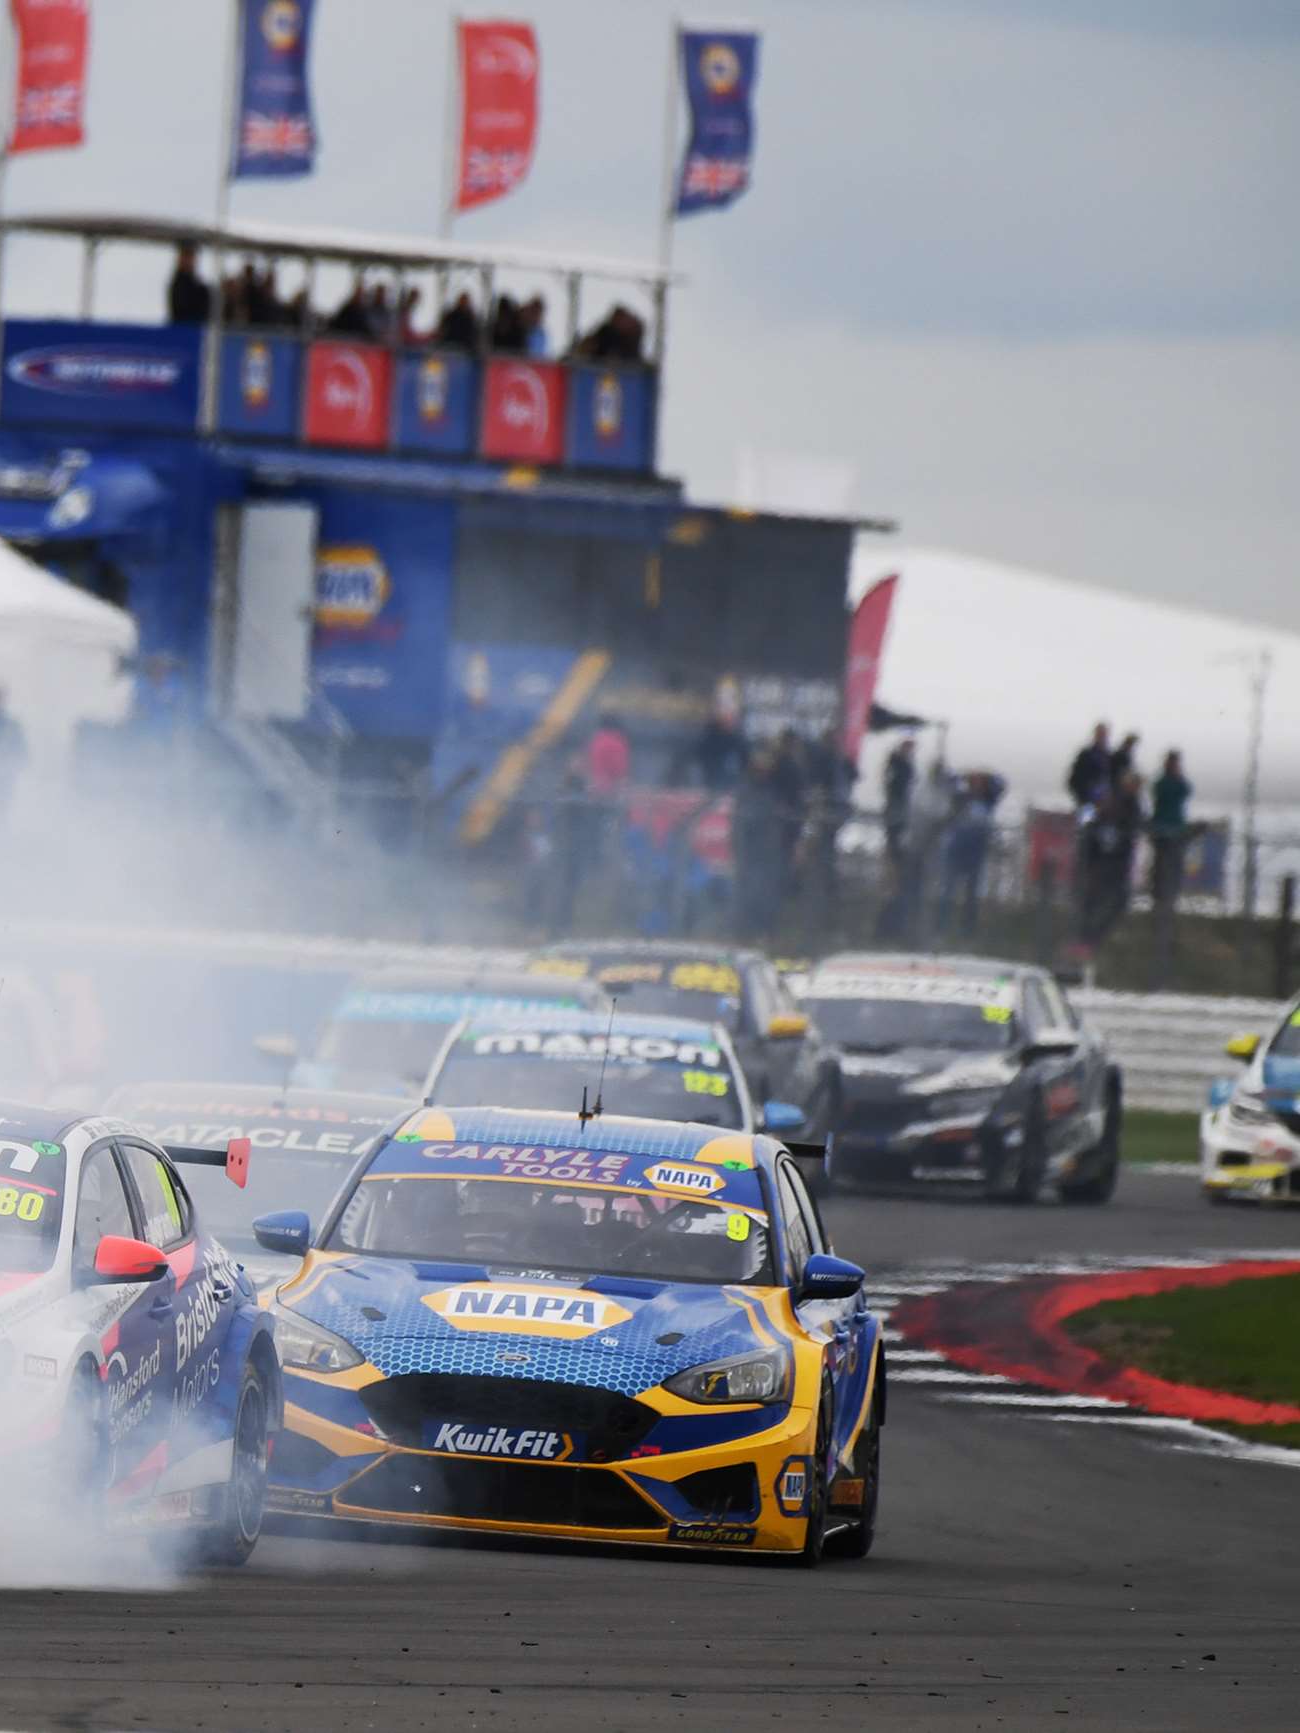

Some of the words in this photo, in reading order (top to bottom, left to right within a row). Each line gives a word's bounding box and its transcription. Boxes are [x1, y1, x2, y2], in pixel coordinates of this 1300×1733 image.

[421, 1142, 633, 1169] CARLYLE
[501, 1161, 622, 1184] TOOLS
[656, 1168, 713, 1190] NAPA
[726, 1213, 750, 1242] 9
[454, 1290, 596, 1325] NAPA
[434, 1422, 560, 1458] KwikFit
